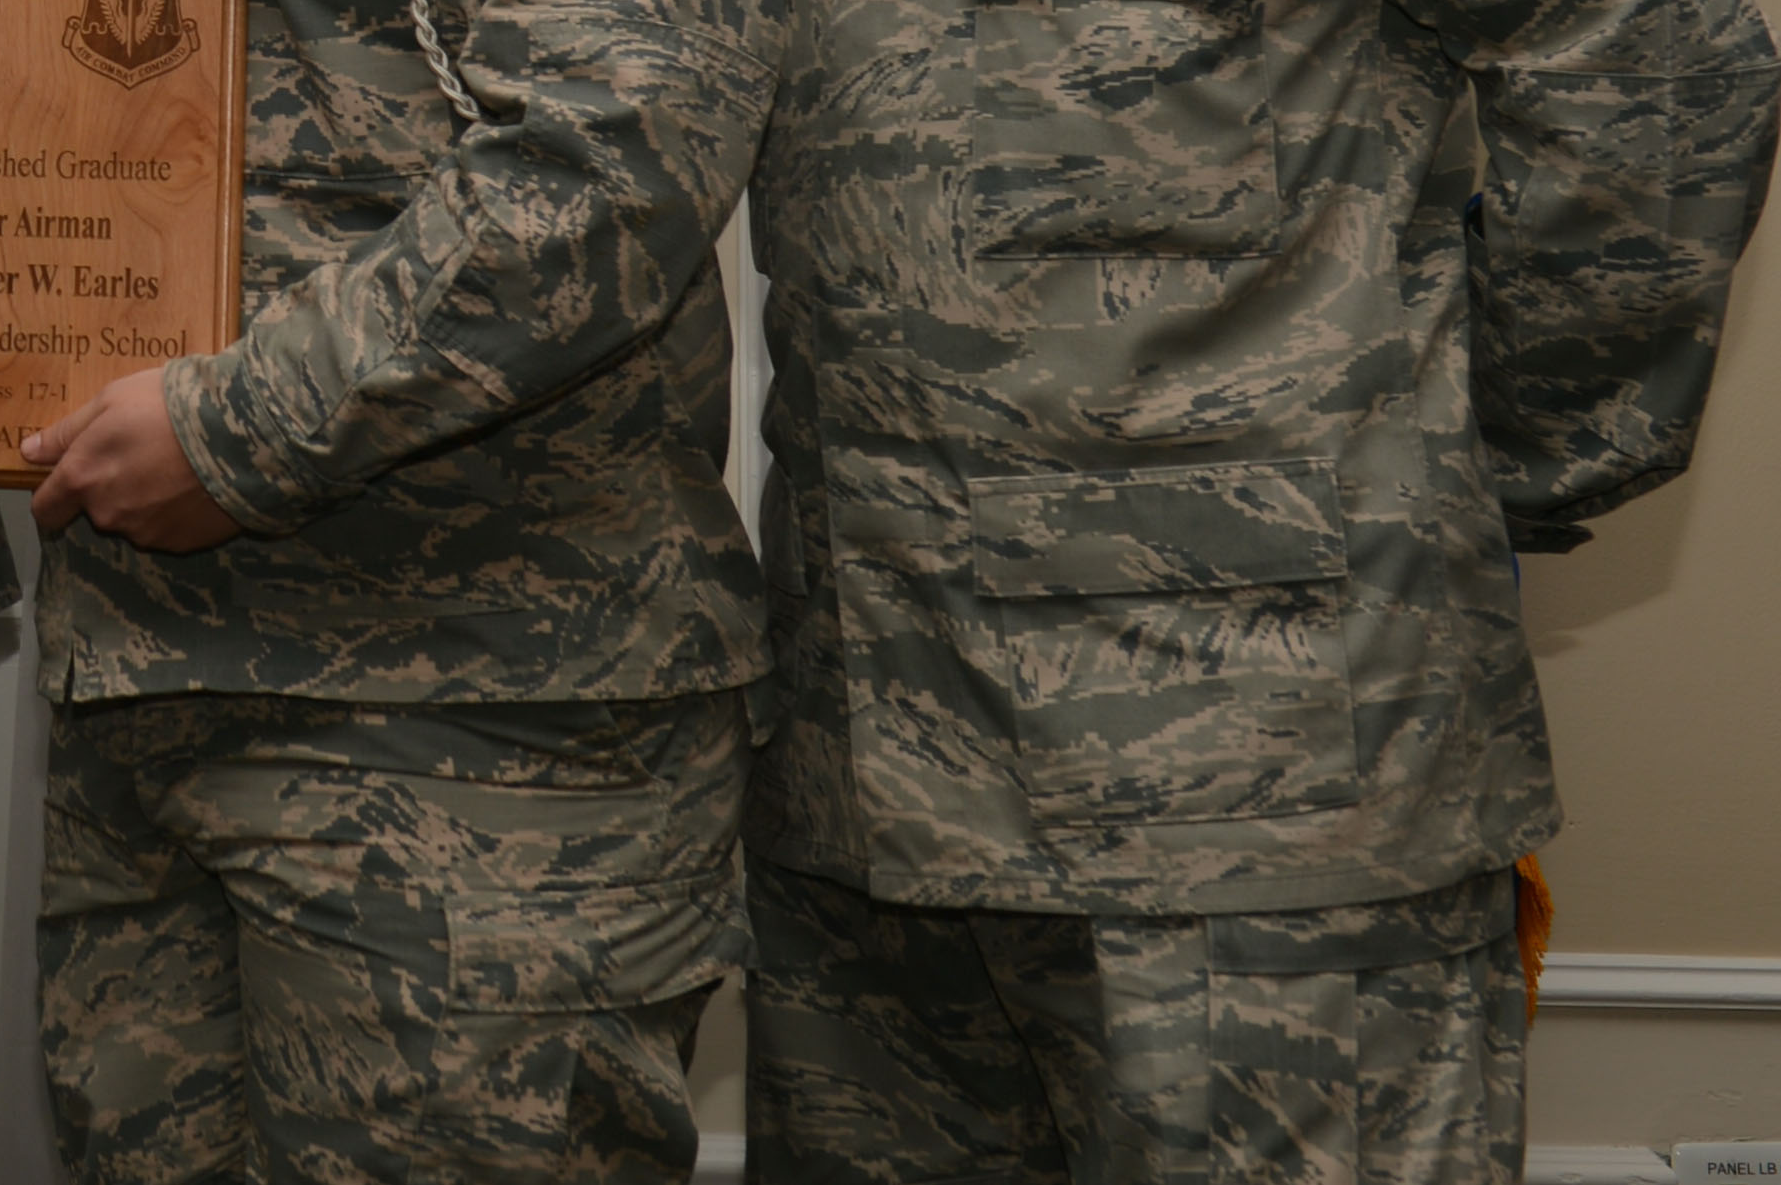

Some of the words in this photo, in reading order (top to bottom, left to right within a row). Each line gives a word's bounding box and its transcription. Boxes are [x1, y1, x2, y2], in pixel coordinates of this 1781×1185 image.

[76, 46, 90, 63] AIR
[93, 58, 135, 83] COMBAT
[138, 46, 186, 77] COMMAND
[56, 150, 171, 181] Graduate
[14, 206, 112, 240] Airman
[27, 264, 62, 296] W.
[73, 265, 160, 300] Earles
[99, 326, 187, 357] School
[27, 382, 68, 402] 17-1
[1707, 1162, 1755, 1175] PANEL
[1759, 1162, 1778, 1175] LB
